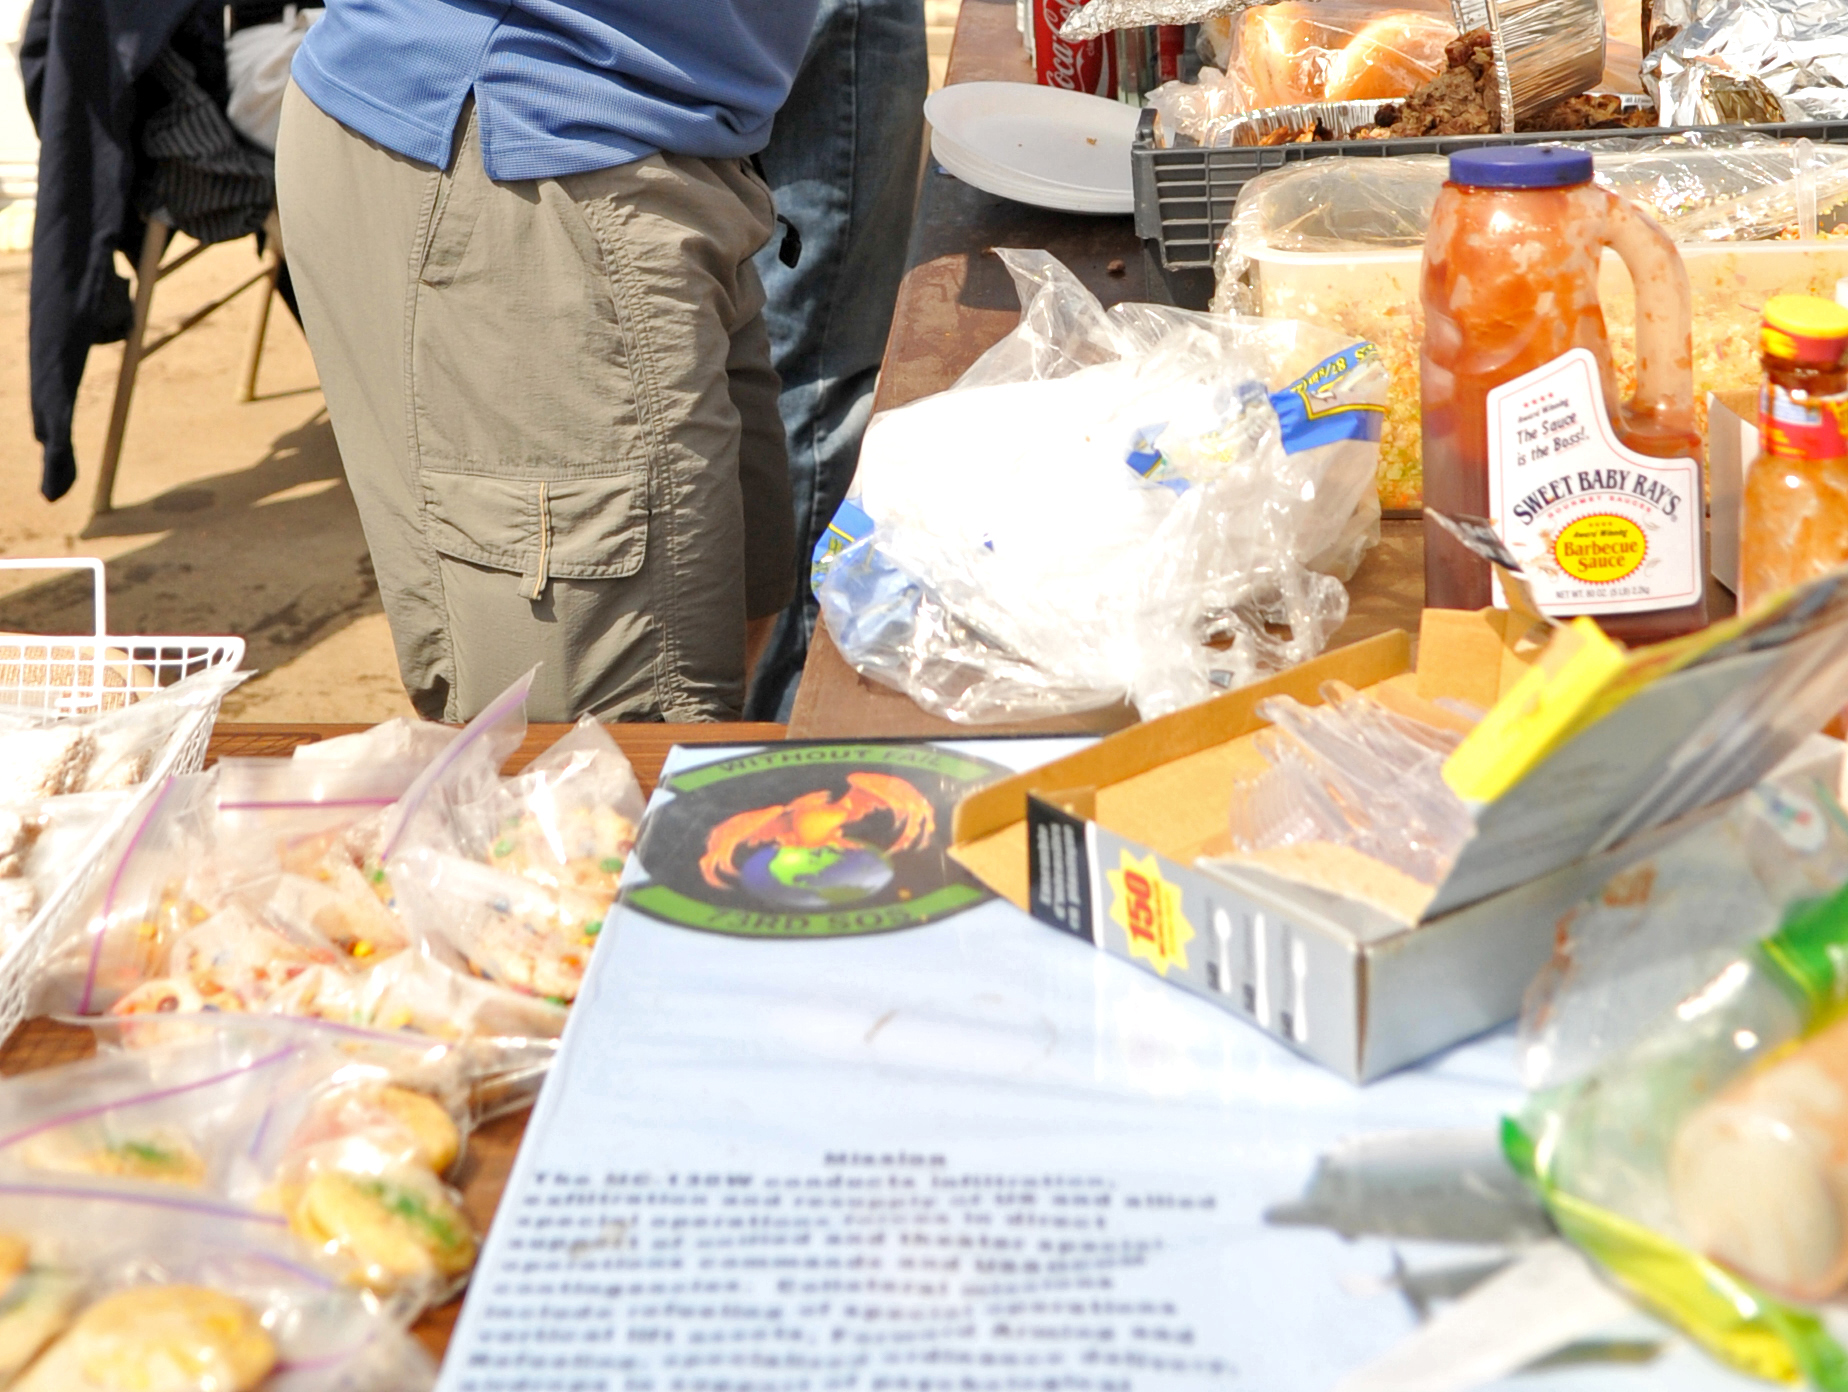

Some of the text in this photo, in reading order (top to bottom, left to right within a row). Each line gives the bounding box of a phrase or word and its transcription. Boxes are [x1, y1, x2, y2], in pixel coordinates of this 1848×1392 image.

[1516, 412, 1577, 445] The Sauce
[1516, 451, 1527, 467] is
[1530, 442, 1550, 463] the
[1513, 468, 1682, 526] SWEET BABY RAY'S
[1563, 540, 1640, 557] Barbecue
[1577, 556, 1627, 574] Sauce
[1556, 589, 1571, 600] NET
[719, 749, 869, 773] WITHOUT
[1124, 869, 1156, 943] 150
[828, 908, 912, 930] SOS
